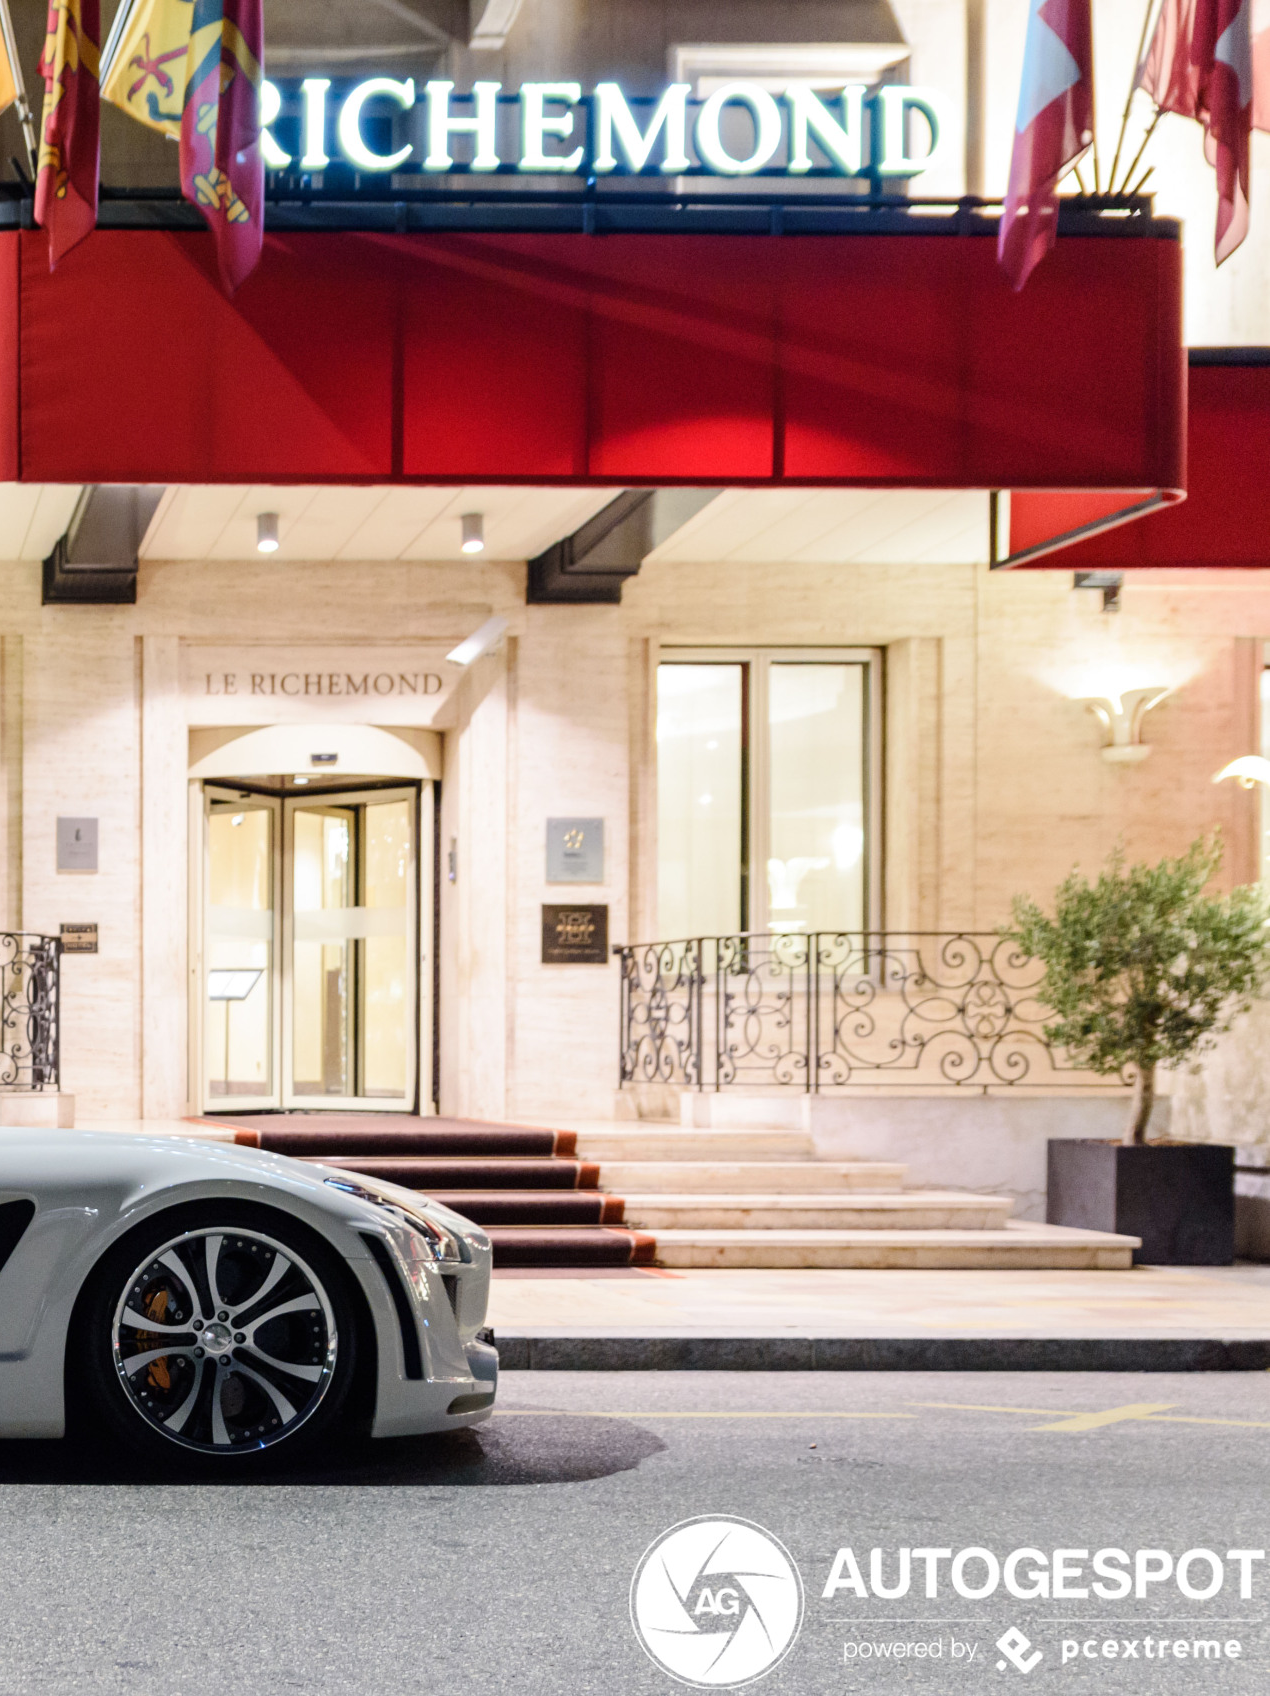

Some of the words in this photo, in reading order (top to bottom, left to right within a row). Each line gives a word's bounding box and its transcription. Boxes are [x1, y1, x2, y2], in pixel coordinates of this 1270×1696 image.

[260, 76, 943, 176] RICHEMOND
[204, 673, 238, 695] LE
[250, 672, 443, 696] RICHEMOND
